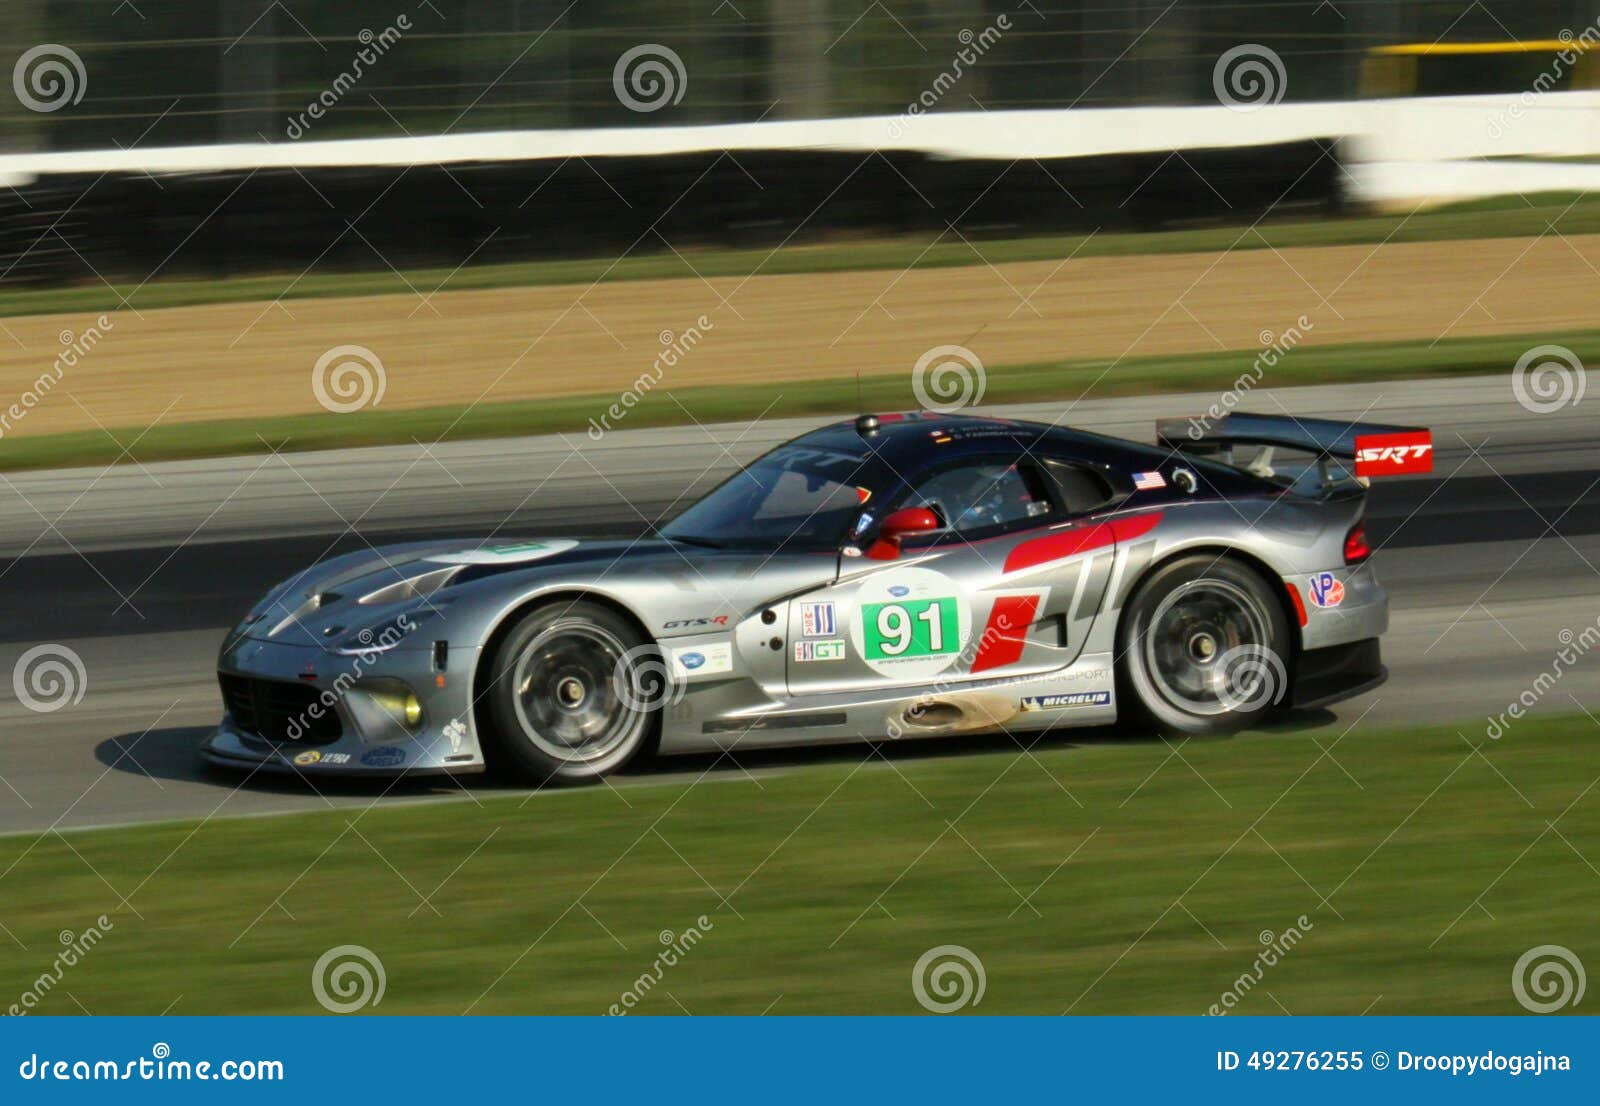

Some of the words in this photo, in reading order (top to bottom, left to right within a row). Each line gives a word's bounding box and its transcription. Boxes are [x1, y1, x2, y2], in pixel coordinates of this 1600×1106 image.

[1355, 444, 1433, 464] SRT
[1310, 573, 1334, 606] VP
[876, 602, 944, 656] 91
[815, 642, 845, 658] GT
[1042, 693, 1107, 706] MICHELIN
